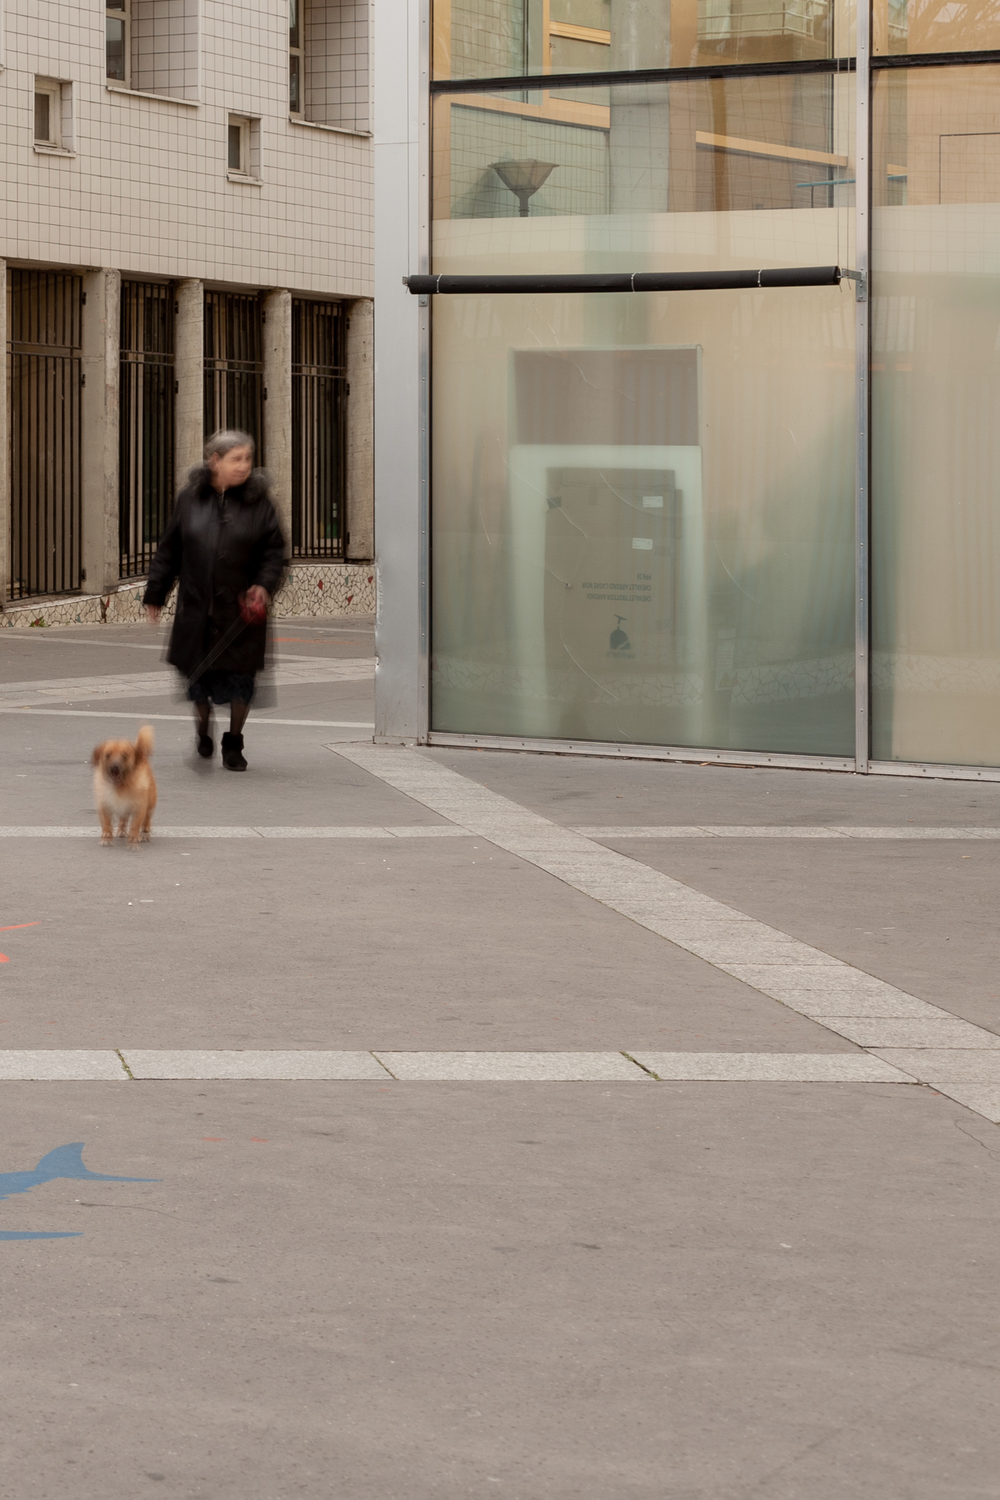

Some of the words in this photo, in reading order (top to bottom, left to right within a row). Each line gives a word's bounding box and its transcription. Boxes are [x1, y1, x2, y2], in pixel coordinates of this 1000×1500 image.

[593, 582, 608, 590] CADRE
[609, 583, 628, 591] ARRONDI
[629, 583, 652, 591] CHEVALET
[586, 593, 606, 601] ARRONDI
[607, 594, 628, 602] TROTTOIR
[629, 594, 652, 602] CHEVALET
